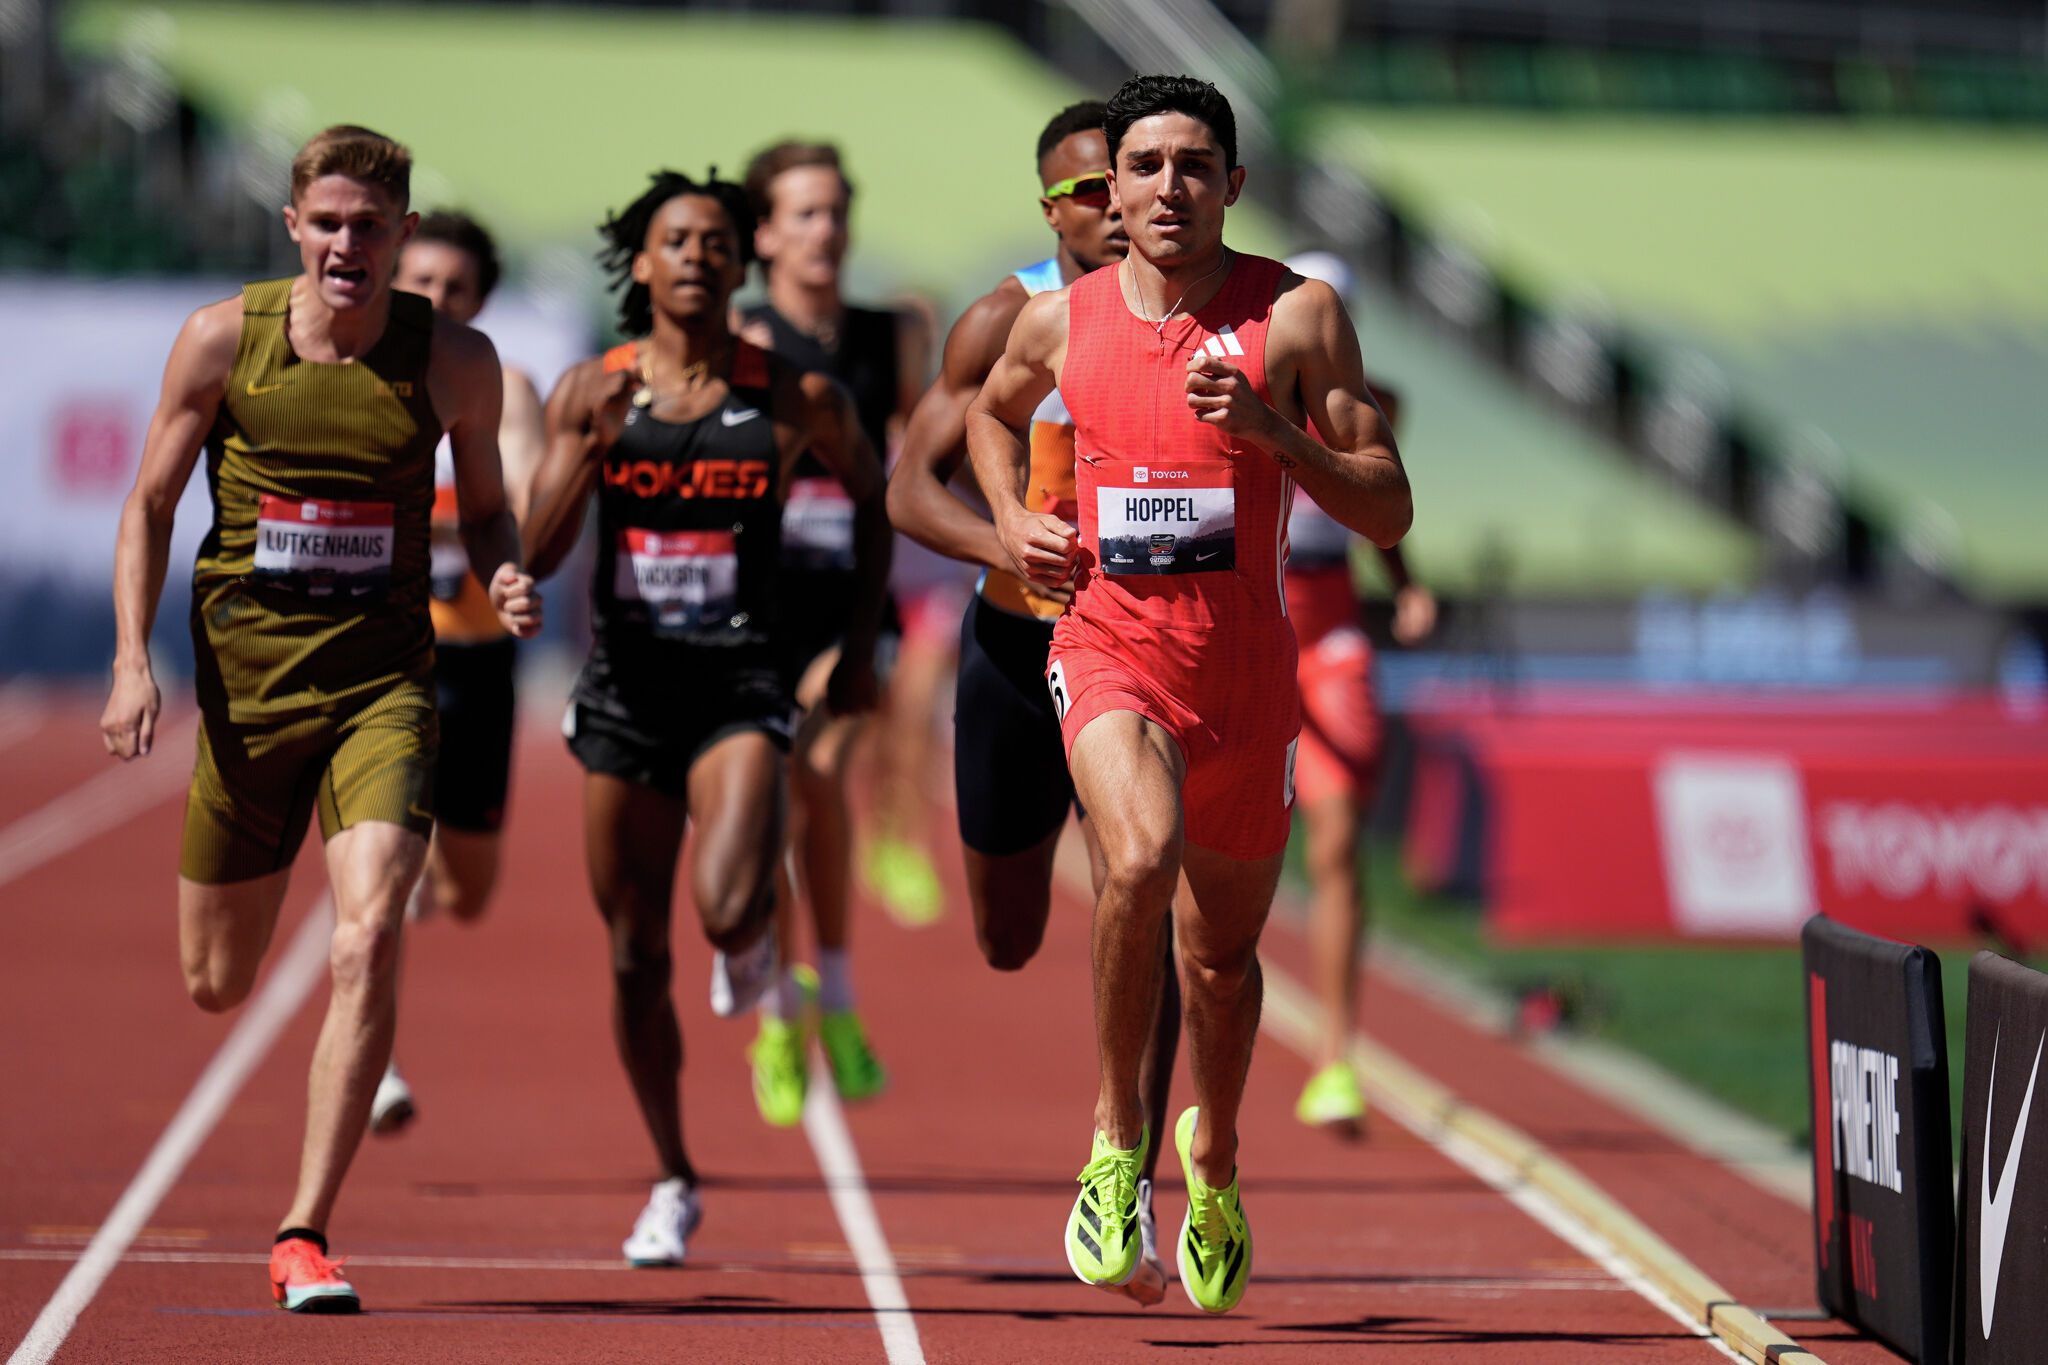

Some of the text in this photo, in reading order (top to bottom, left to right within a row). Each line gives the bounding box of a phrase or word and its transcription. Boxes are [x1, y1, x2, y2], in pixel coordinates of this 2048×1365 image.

[1151, 471, 1189, 479] TOYOTA
[1125, 497, 1199, 522] HOPPEL
[266, 530, 384, 558] LUTKENHAUS
